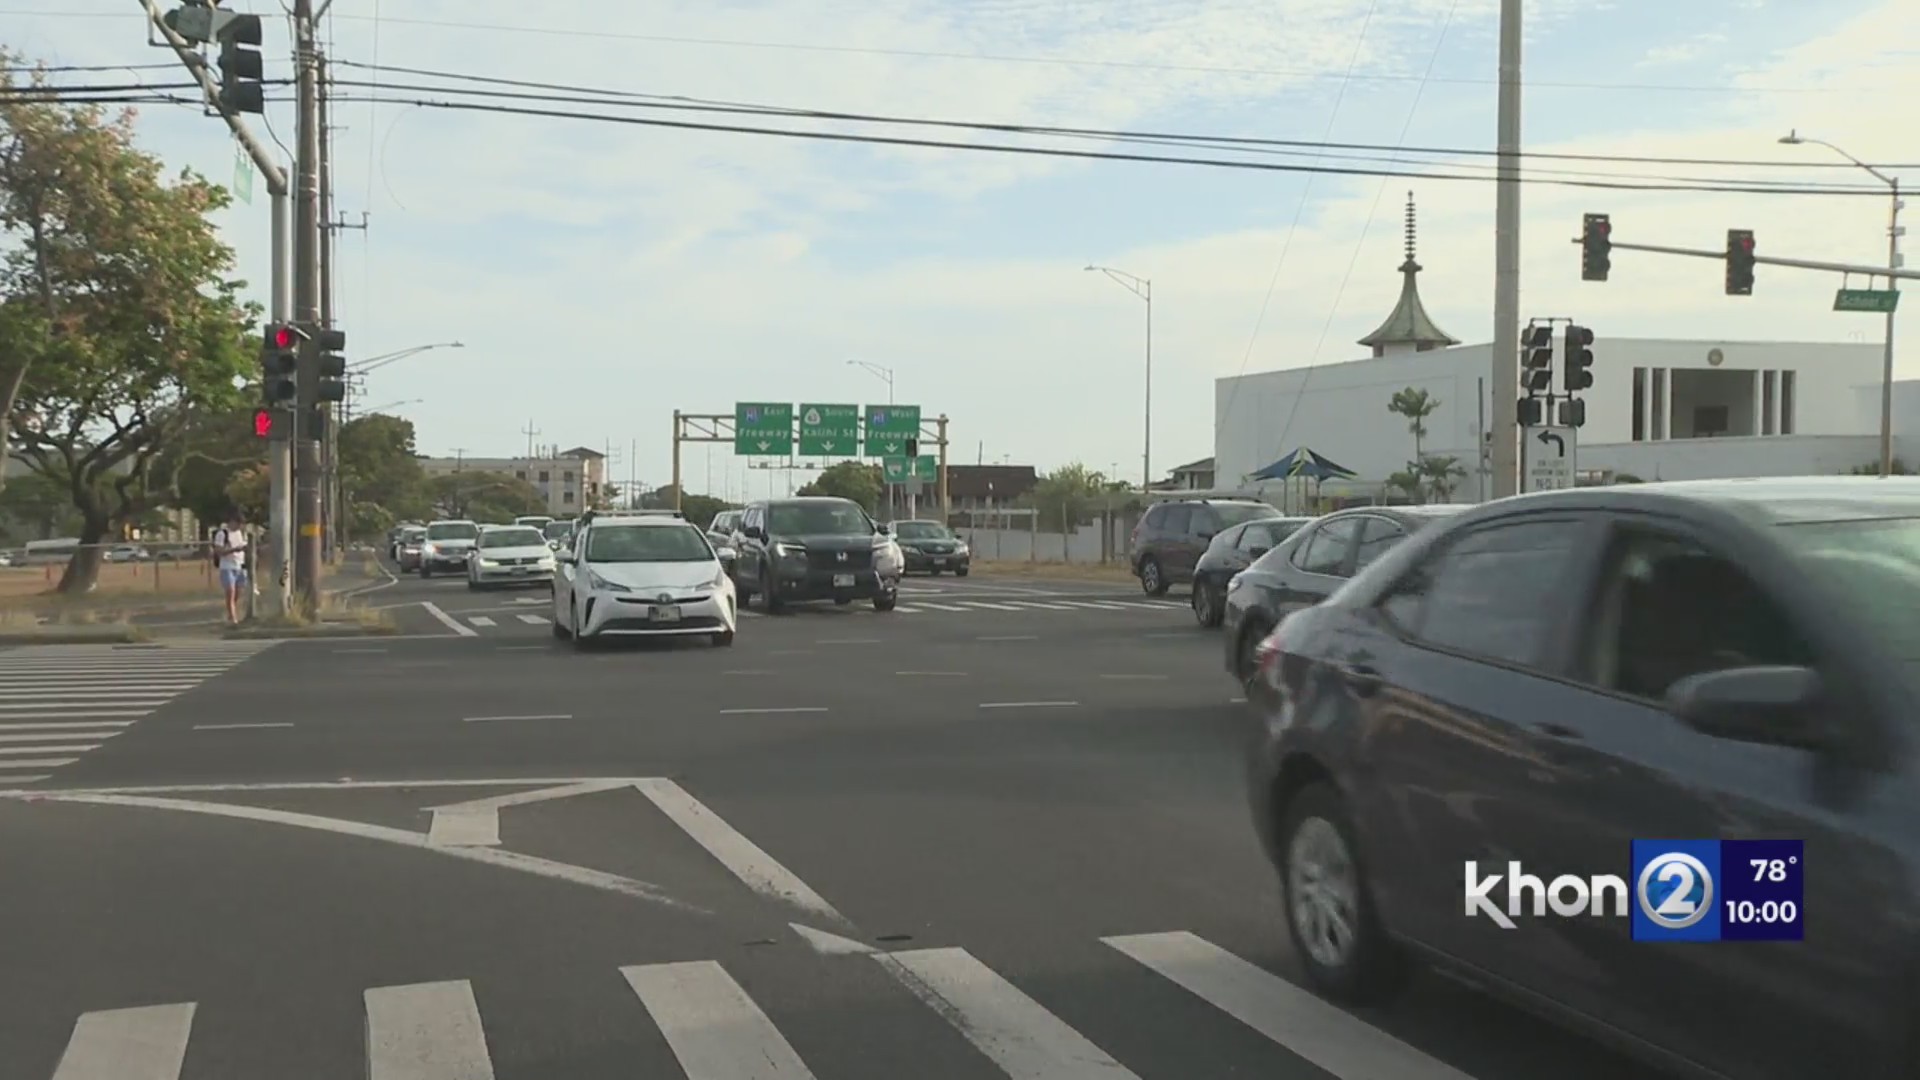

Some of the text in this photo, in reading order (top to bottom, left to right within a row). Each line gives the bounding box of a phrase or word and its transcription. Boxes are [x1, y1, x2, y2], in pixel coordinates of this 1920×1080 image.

[763, 406, 786, 417] East
[891, 408, 914, 418] West
[738, 427, 789, 439] Freeway
[802, 427, 855, 438] Kalihi St
[868, 429, 917, 440] Freeway
